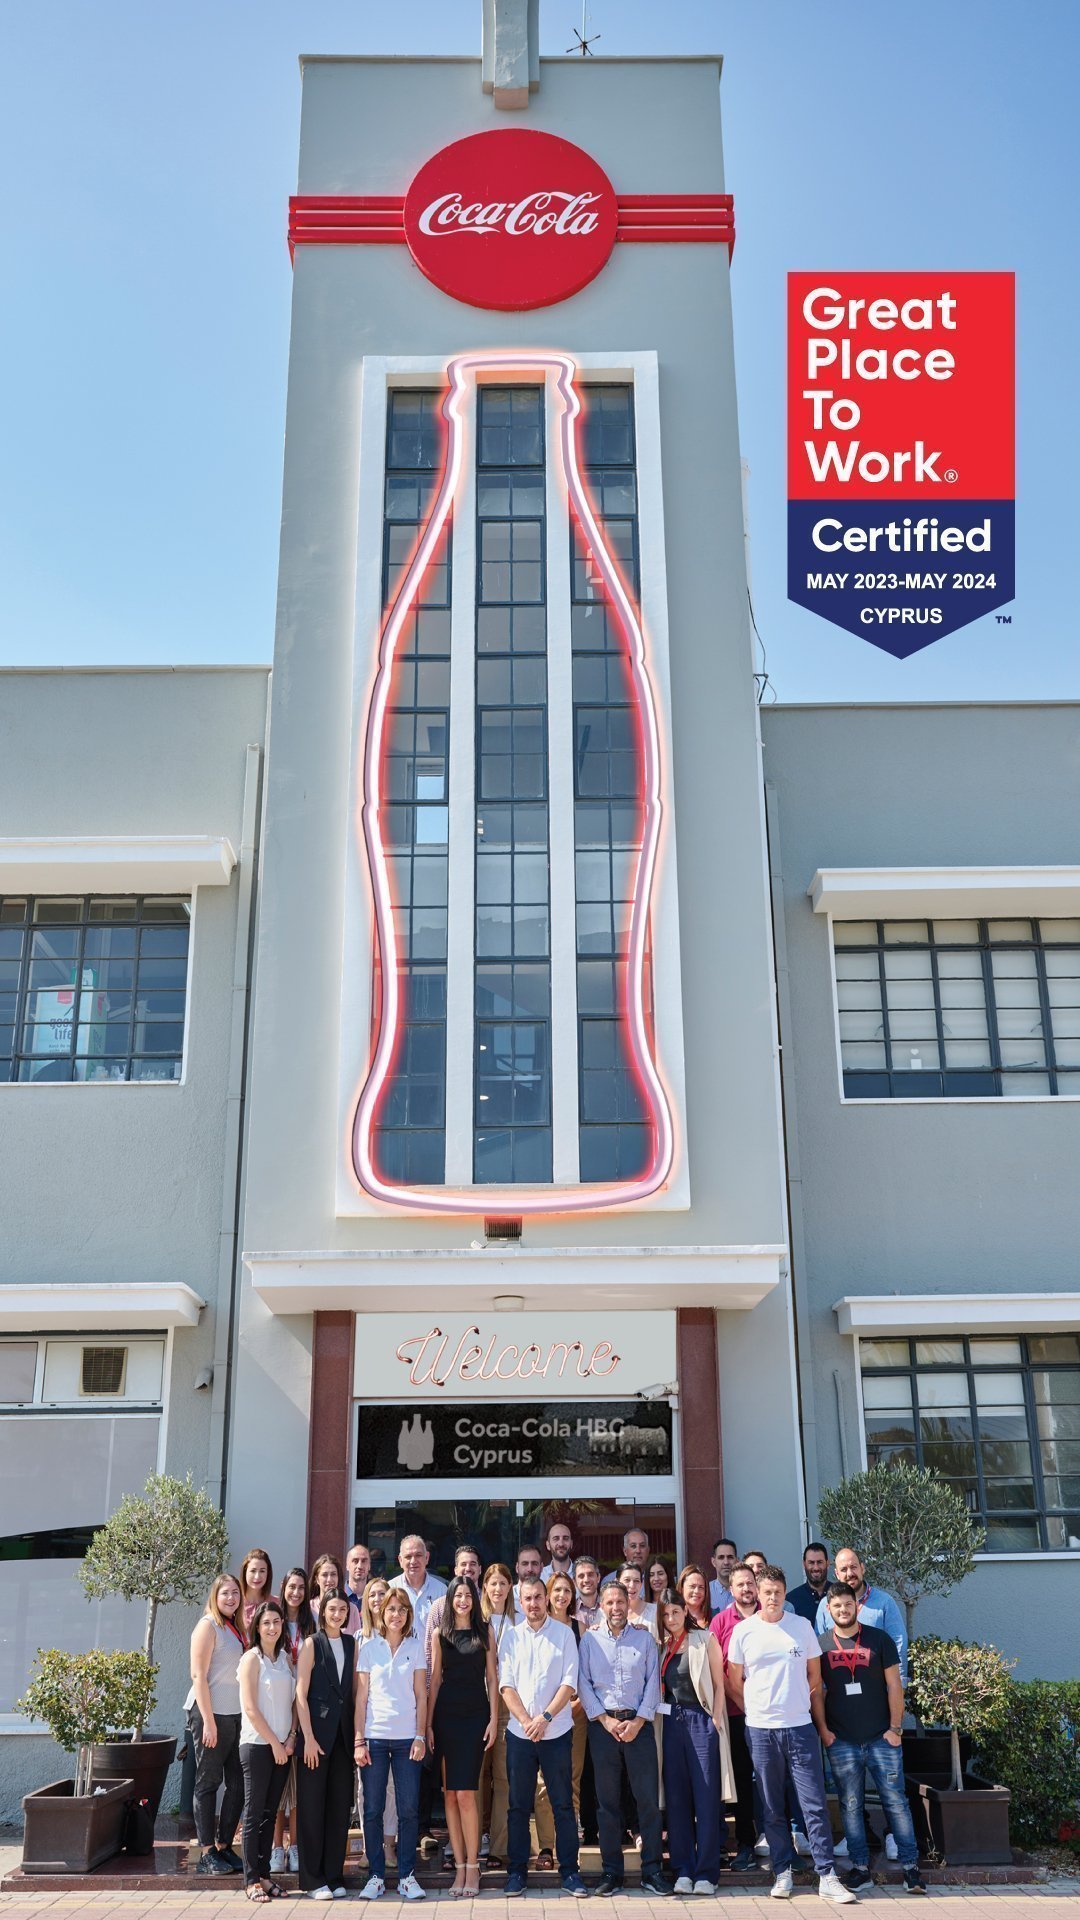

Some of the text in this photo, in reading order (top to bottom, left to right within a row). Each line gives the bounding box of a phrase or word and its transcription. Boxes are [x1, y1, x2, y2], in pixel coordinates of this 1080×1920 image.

[418, 191, 603, 236] Coca-Cola
[49, 1018, 73, 1030] goo
[395, 1326, 620, 1386] Welcome
[454, 1418, 625, 1438] Coca-Cola HBC
[453, 1444, 533, 1469] Cyprus
